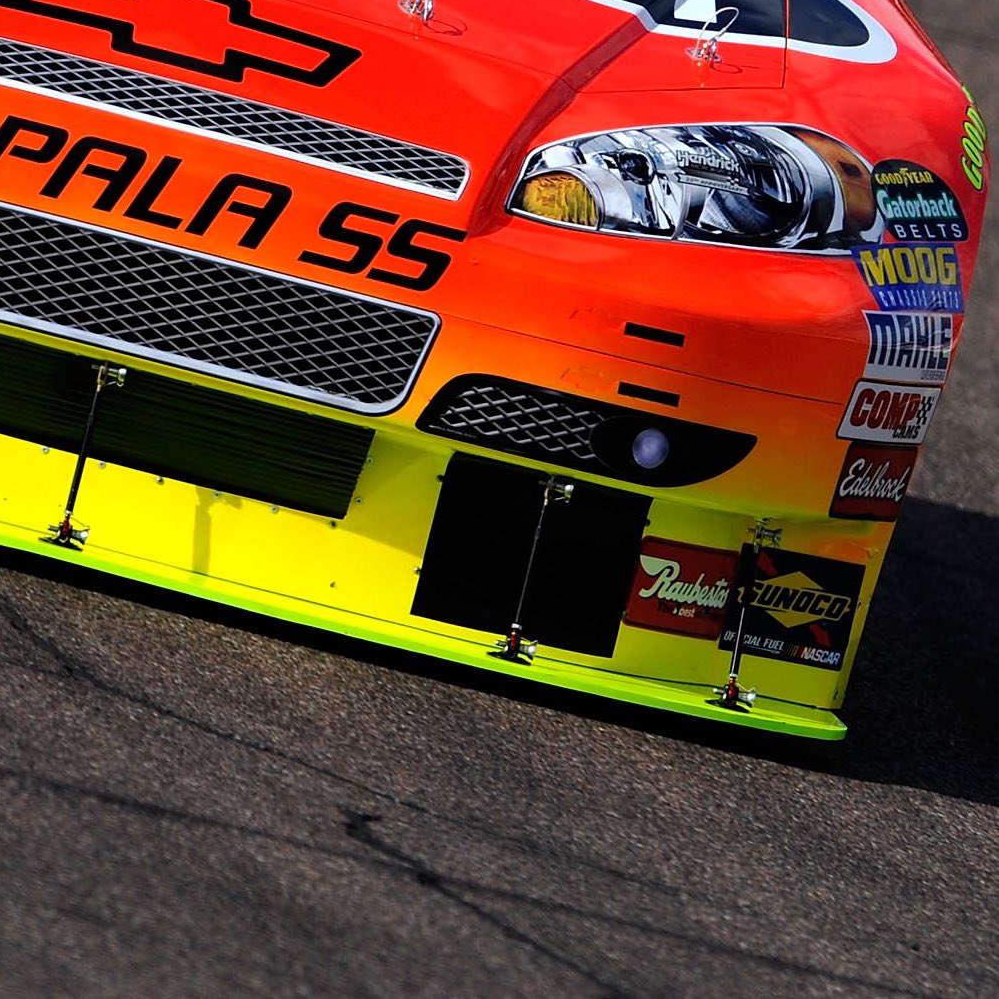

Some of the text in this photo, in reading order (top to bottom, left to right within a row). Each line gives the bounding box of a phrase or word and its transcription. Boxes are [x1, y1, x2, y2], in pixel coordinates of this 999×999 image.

[676, 149, 740, 173] Hendrick
[875, 167, 934, 188] GOODYEAR
[876, 189, 958, 220] Gatorback
[894, 222, 963, 239] BELTS
[296, 201, 470, 292] SS
[859, 247, 957, 287] MOOG
[849, 388, 922, 430] COMP
[892, 425, 921, 440] CAMS
[839, 458, 911, 502] Edelbrock
[752, 580, 847, 620] SUNOCO
[724, 629, 785, 651] OFCIAL FUEL
[801, 646, 841, 665] NASCAR
